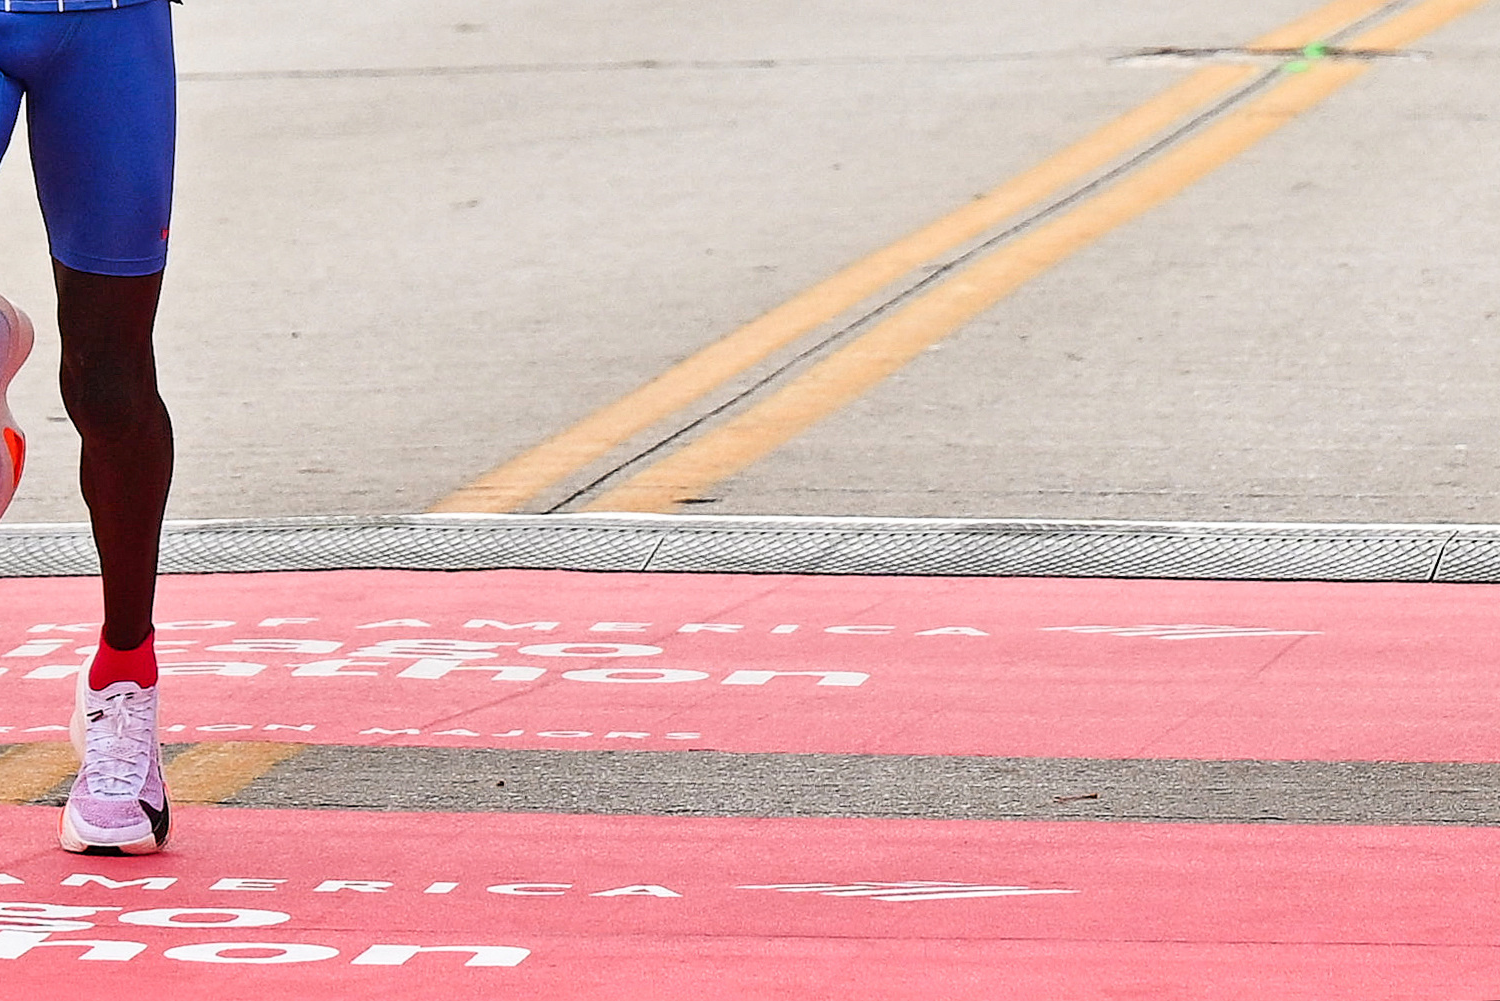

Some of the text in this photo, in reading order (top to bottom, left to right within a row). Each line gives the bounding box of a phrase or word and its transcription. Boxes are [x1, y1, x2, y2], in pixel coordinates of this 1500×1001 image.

[152, 617, 321, 631] OF
[354, 618, 991, 637] AMERICA
[358, 727, 701, 740] MAJORS
